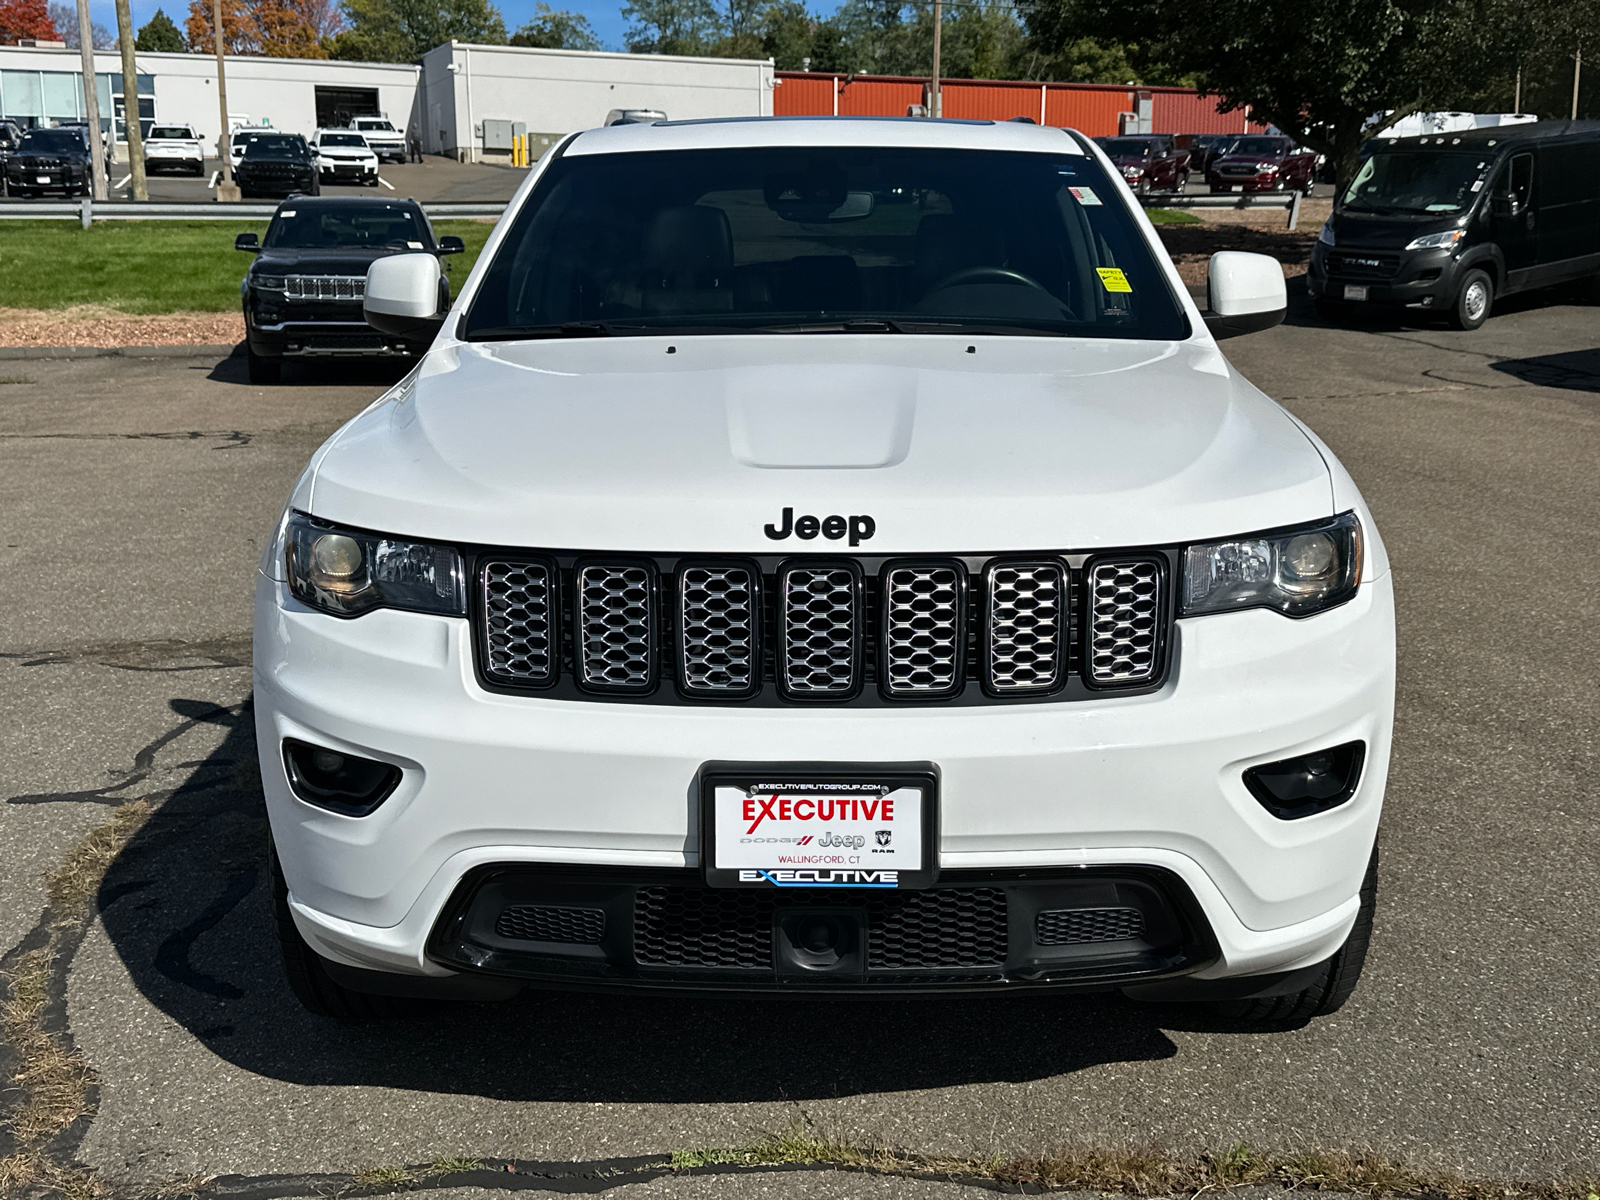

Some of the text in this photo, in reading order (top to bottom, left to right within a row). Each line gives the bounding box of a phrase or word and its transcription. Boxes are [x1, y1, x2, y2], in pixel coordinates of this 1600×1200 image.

[764, 507, 876, 547] Jeep
[742, 795, 894, 834] EXECUTIVE
[819, 832, 866, 850] Jeep
[778, 855, 861, 864] WALLINGFORD, CT
[739, 870, 898, 887] EXECUTIVE
